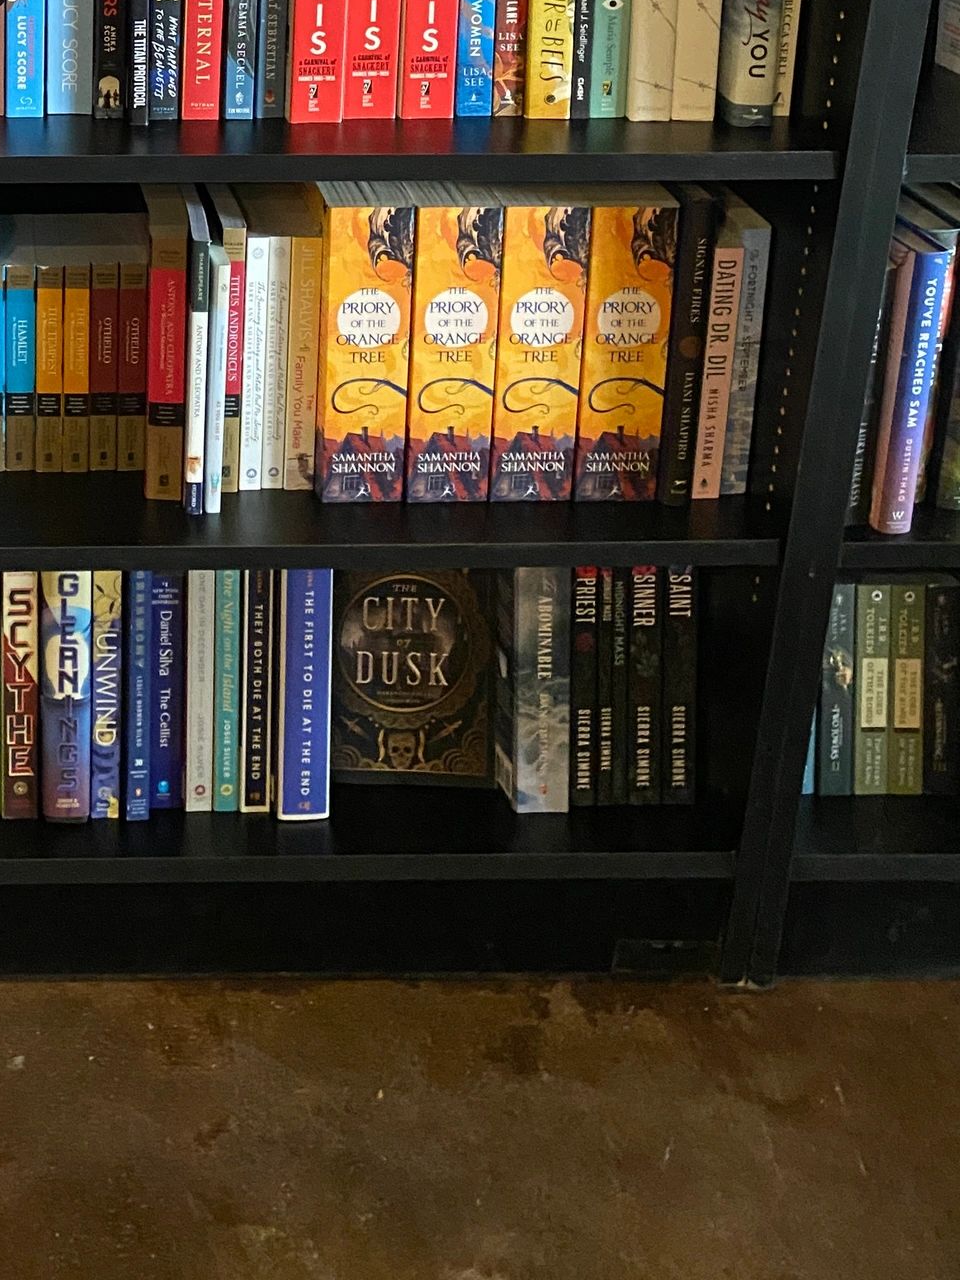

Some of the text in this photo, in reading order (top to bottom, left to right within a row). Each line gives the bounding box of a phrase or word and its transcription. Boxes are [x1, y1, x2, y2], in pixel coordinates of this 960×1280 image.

[470, 0, 482, 57] WOMEN
[749, 29, 768, 79] YOU
[342, 300, 394, 315] PRIORY
[336, 332, 399, 346] ORANGE
[349, 351, 385, 364] TREE
[907, 278, 937, 428] YOU'VE REACHED SAM
[331, 462, 396, 474] SHANNON
[332, 453, 395, 462] SAMANTHA
[362, 597, 445, 631] CITY
[576, 578, 595, 623] PRIEST
[633, 574, 655, 627] SINNER
[669, 575, 691, 617] SAINT
[537, 596, 552, 679] ABOMINABLE
[7, 590, 34, 776] SCYTHE
[95, 633, 118, 745] UNWIND
[159, 610, 172, 748] Daniel Silva The Cellist
[356, 652, 448, 686] DUSK
[301, 592, 314, 795] THE FIRST TO DIE AT THE END
